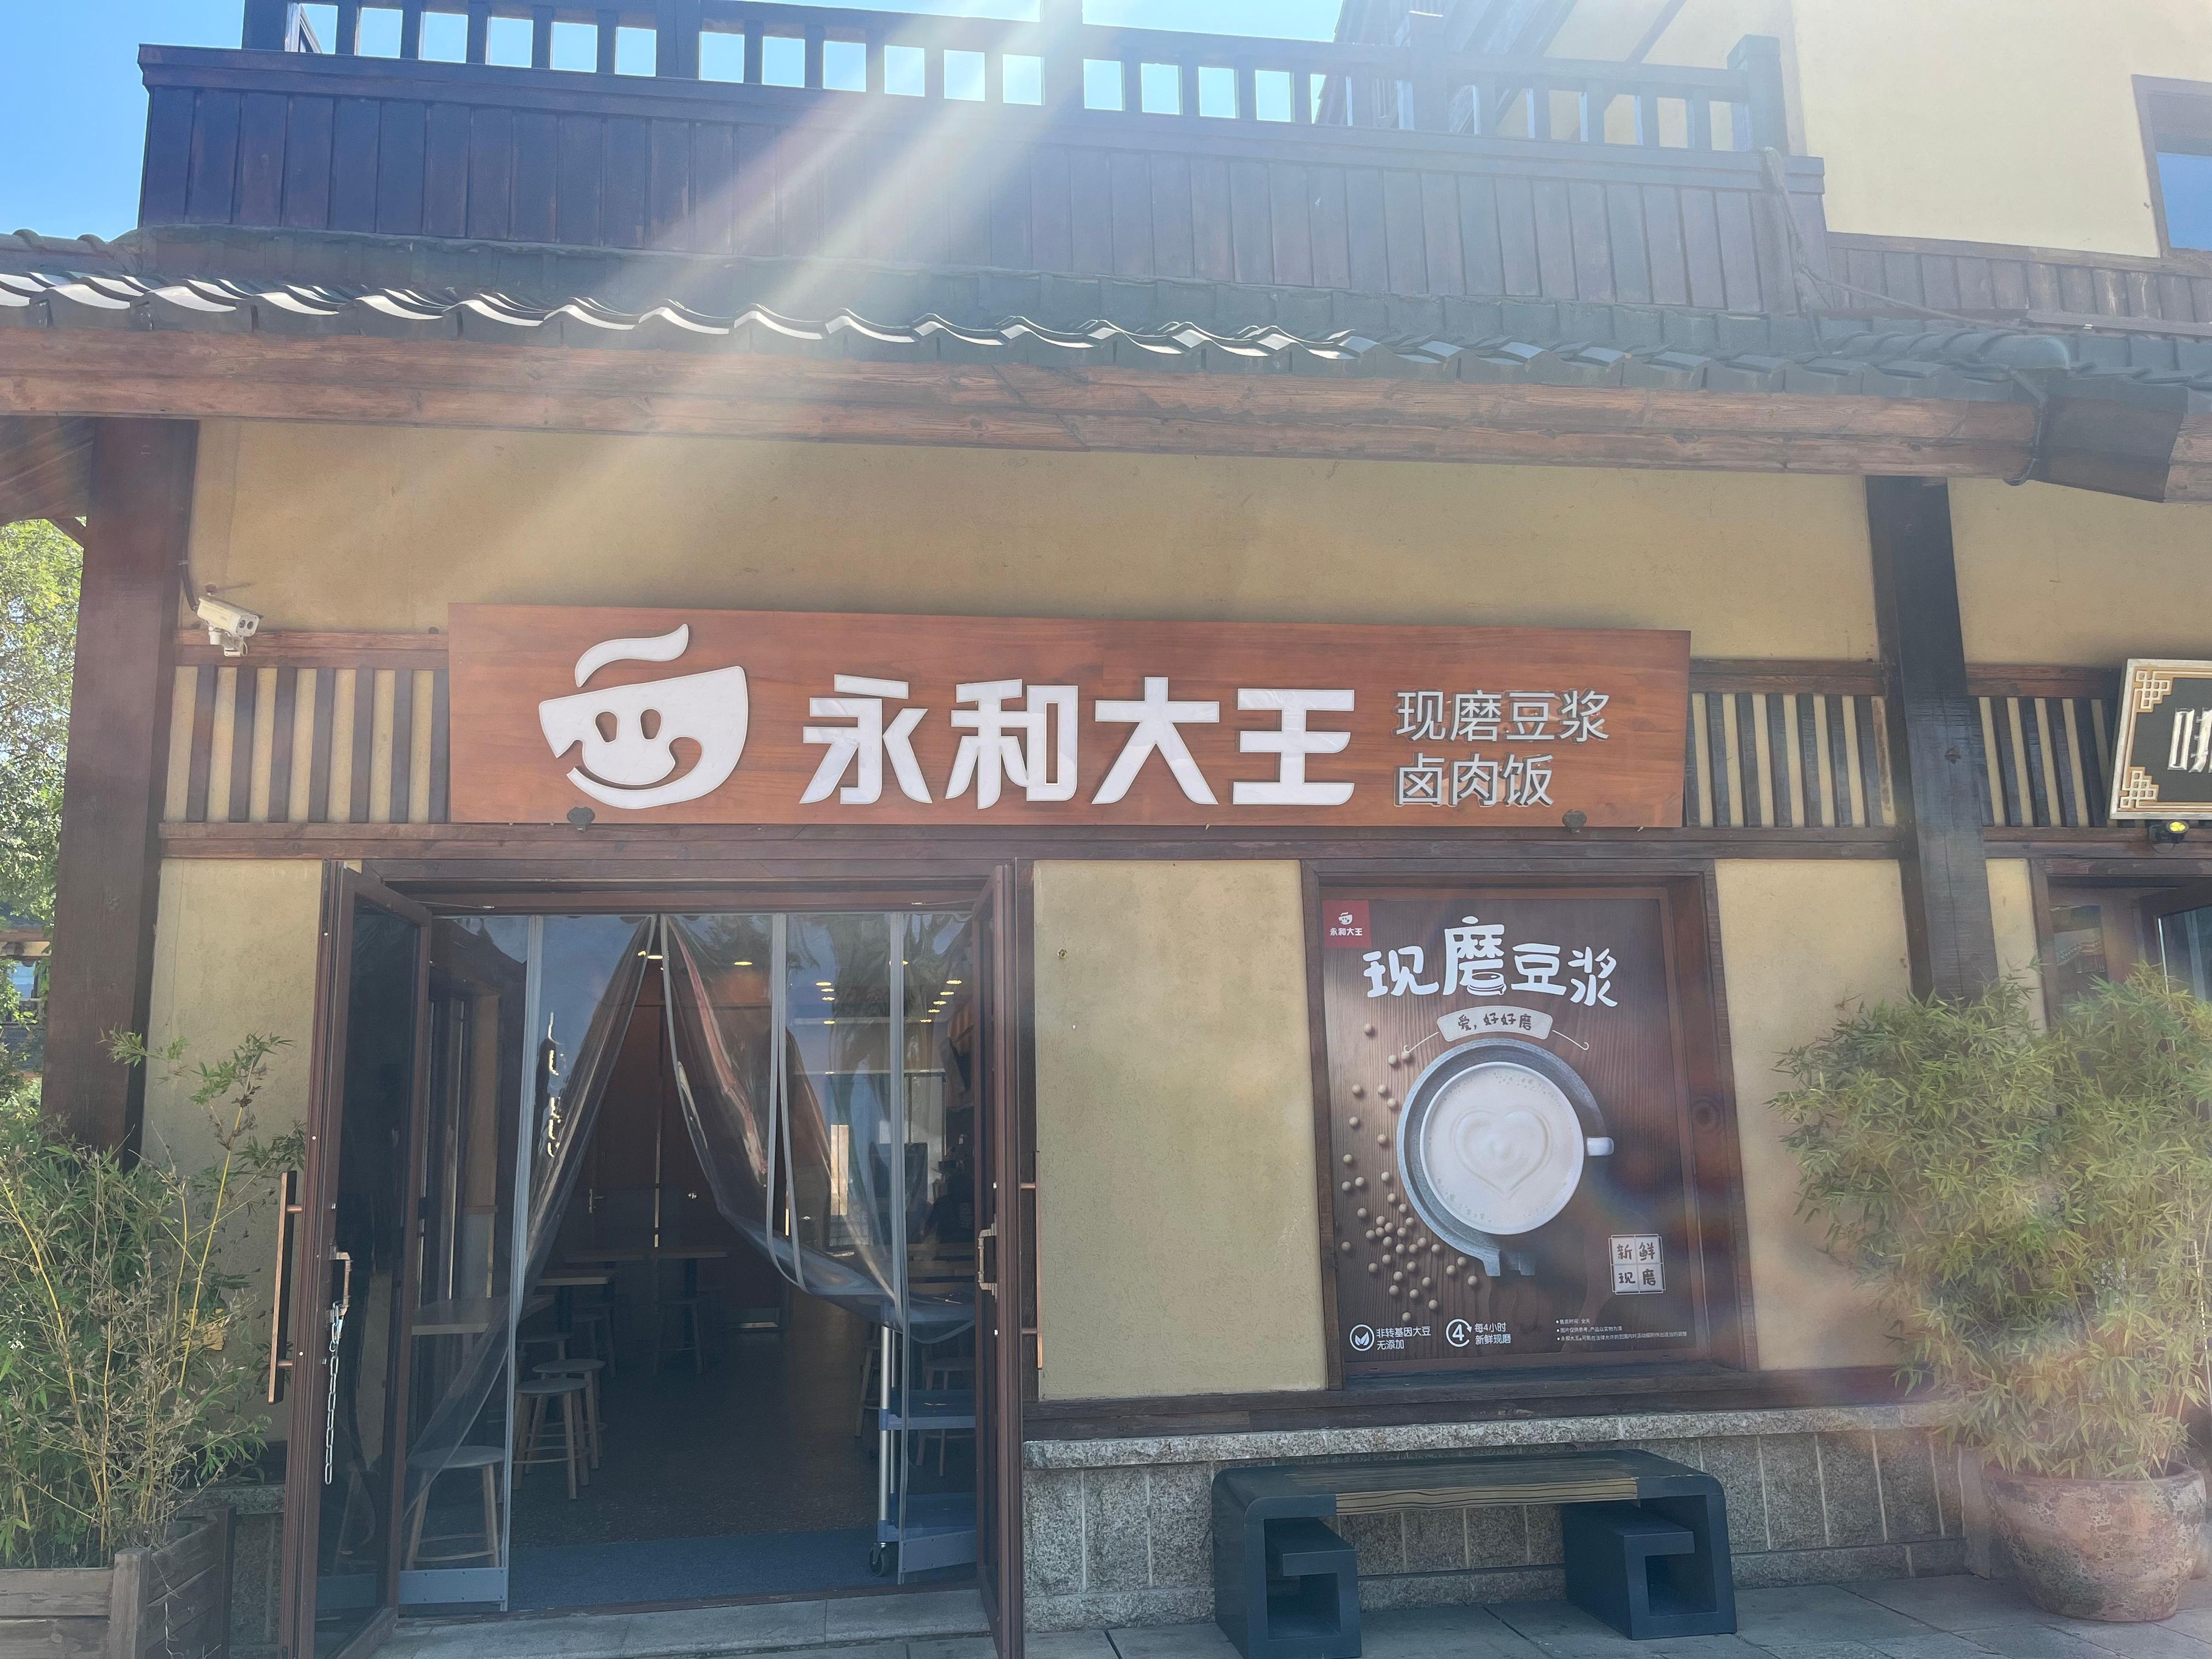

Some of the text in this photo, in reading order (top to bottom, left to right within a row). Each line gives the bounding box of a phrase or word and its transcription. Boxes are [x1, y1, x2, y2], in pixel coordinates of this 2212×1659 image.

[1395, 690, 1611, 743] 现磨豆浆
[799, 674, 1355, 809] 永和大王
[1397, 753, 1555, 806] 卤肉饭
[1330, 927, 1363, 936] 永和大王
[1362, 916, 1618, 1007] 现磨豆浆
[1376, 1325, 1431, 1338] 非转基因大豆
[1474, 1322, 1507, 1333] 每4小时
[1376, 1339, 1404, 1351] 无添加
[1474, 1334, 1512, 1345] 新鲜现磨
